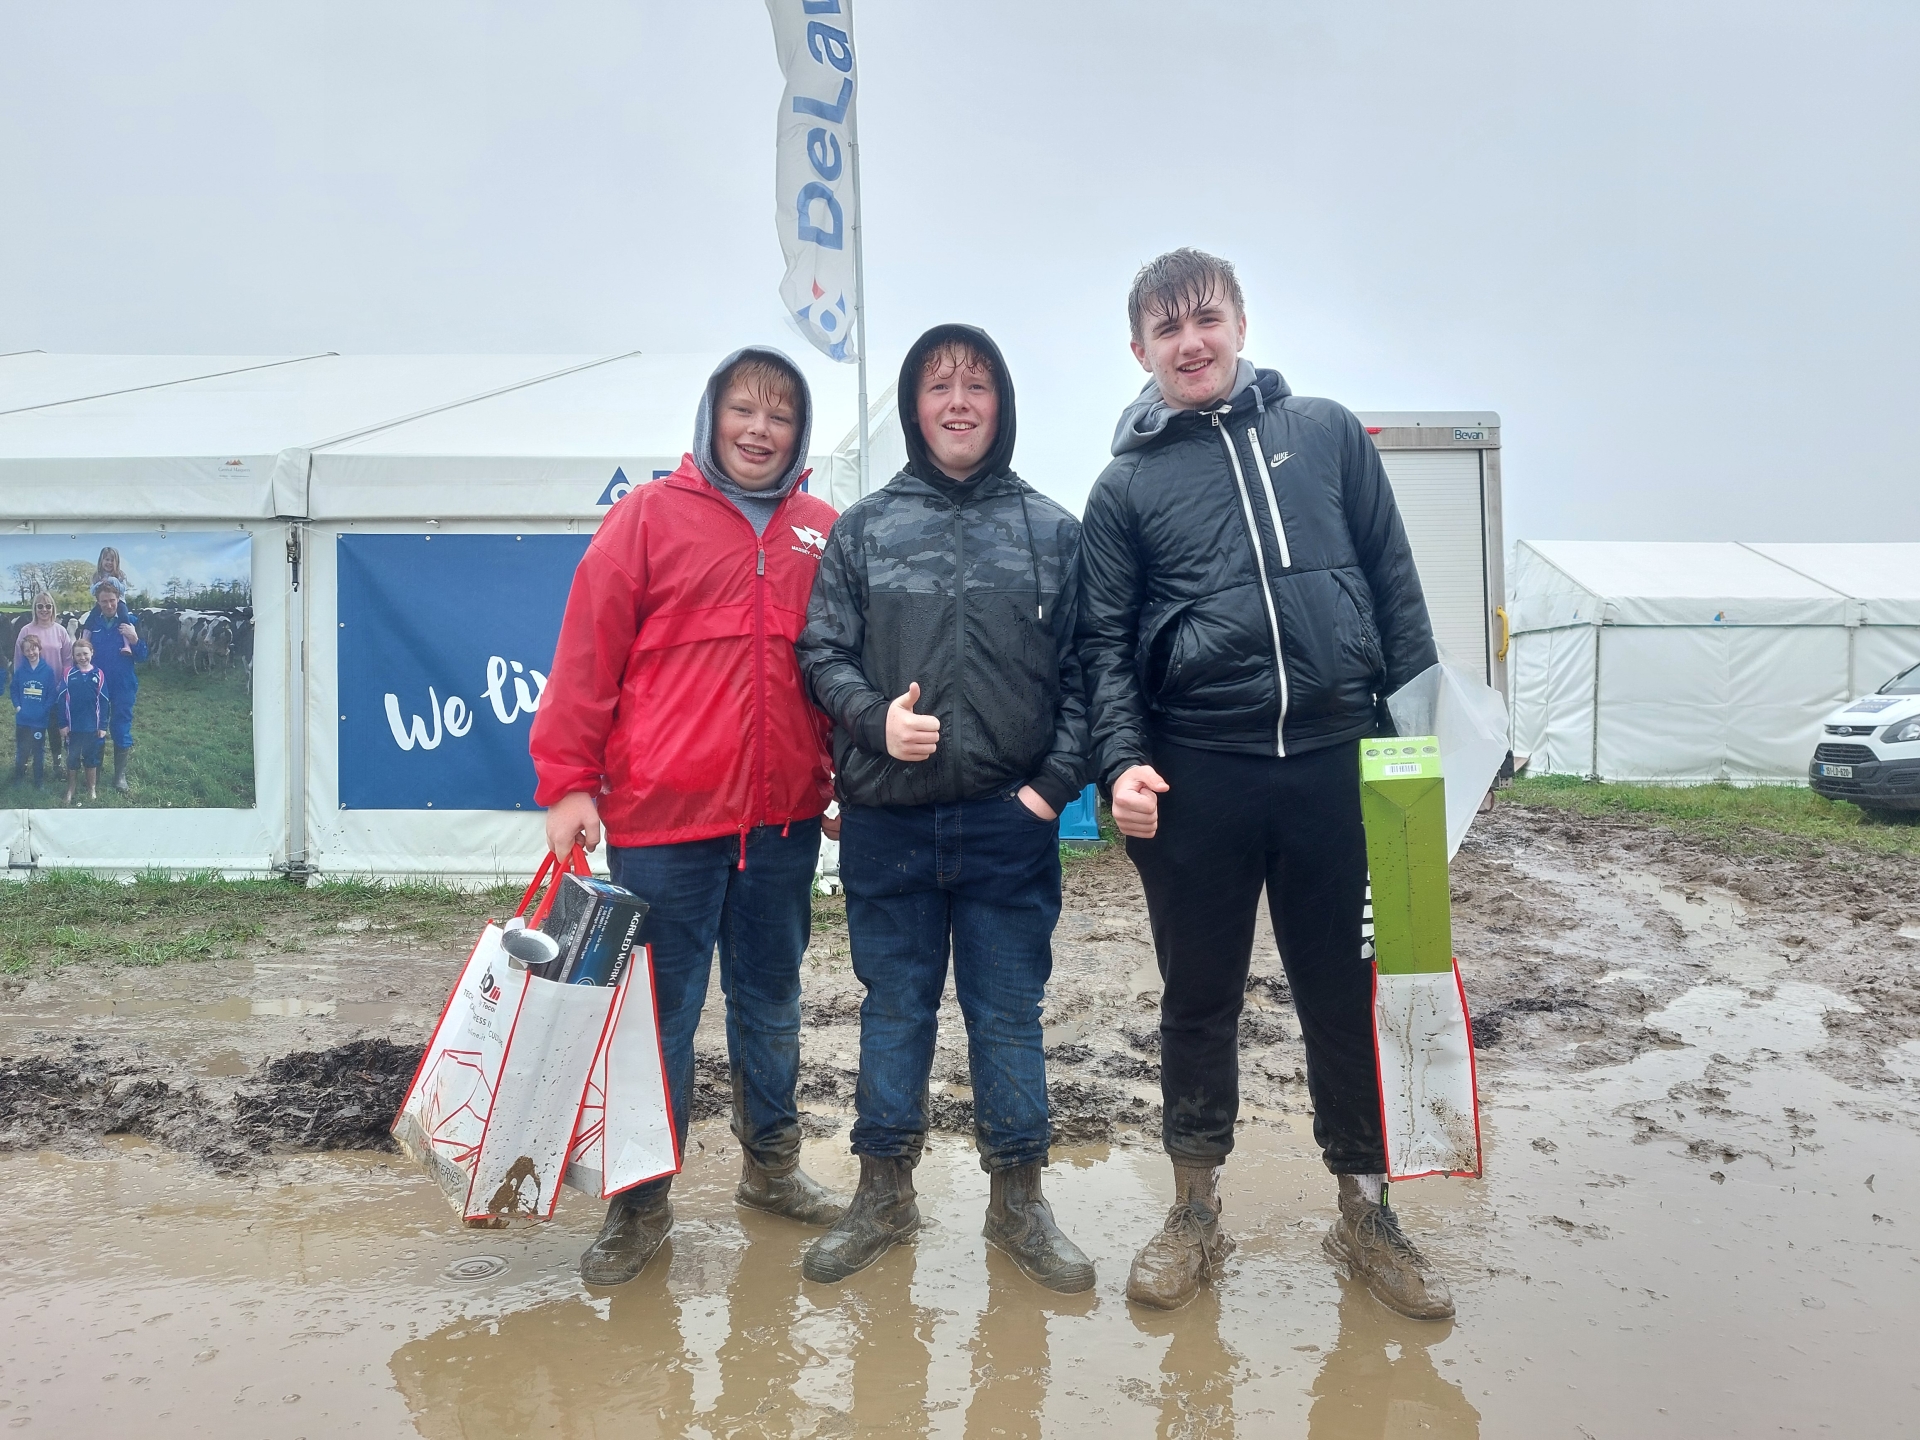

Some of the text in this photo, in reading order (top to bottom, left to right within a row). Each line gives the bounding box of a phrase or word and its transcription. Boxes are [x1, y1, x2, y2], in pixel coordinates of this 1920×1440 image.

[1454, 429, 1484, 440] Bevan
[1273, 451, 1289, 462] NIKE
[384, 685, 473, 751] We
[621, 911, 641, 951] AGRILED
[608, 952, 627, 981] WORK
